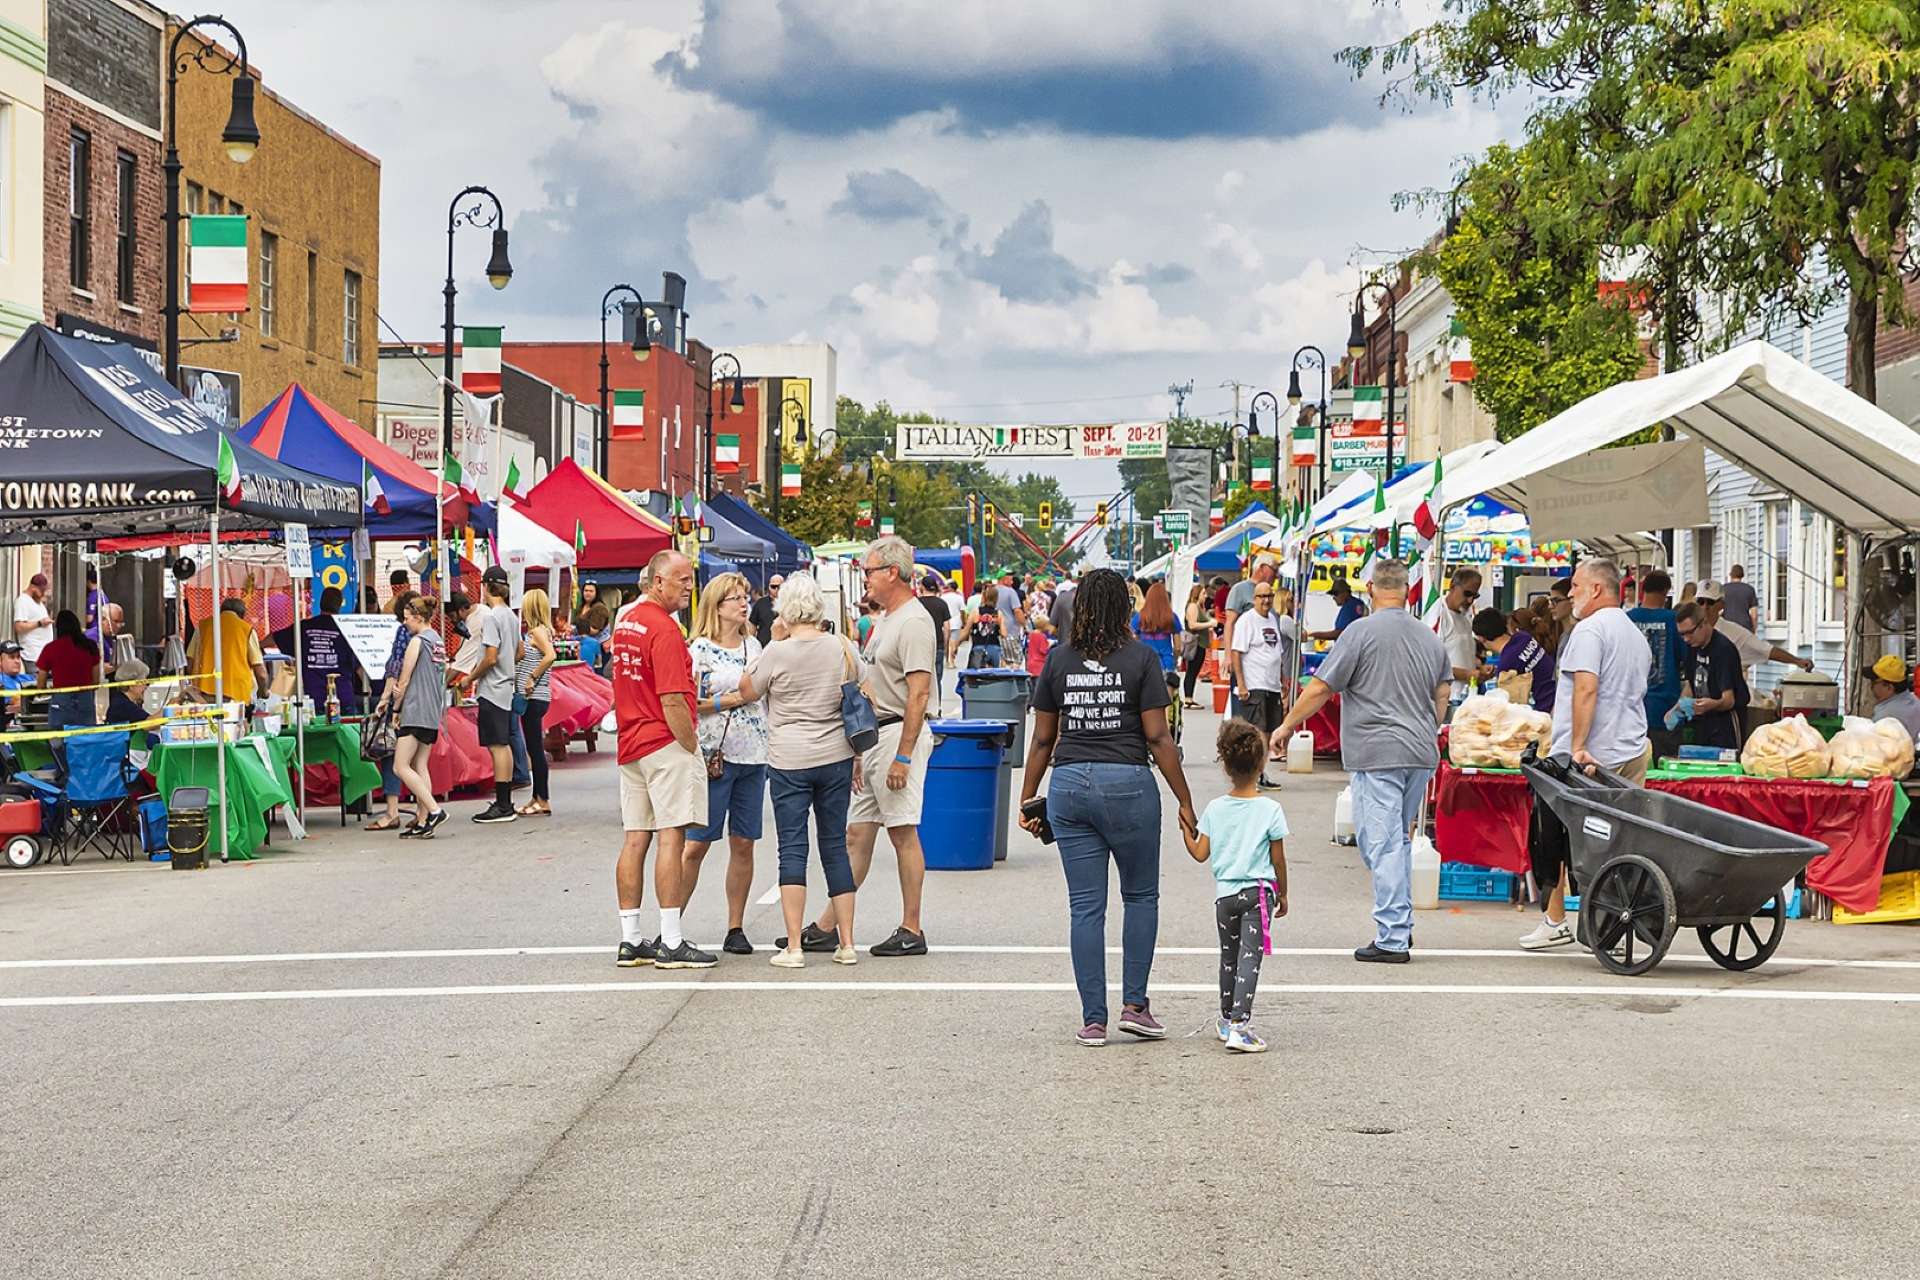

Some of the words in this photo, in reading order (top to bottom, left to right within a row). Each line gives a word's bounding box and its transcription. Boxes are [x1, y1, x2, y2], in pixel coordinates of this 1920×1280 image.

[0, 416, 27, 427] ST
[0, 429, 104, 439] METOWN
[392, 421, 463, 447] Bieges
[904, 427, 995, 450] ITALIAN
[1022, 427, 1077, 450] FEST
[1083, 426, 1116, 442] SEPT.
[1127, 426, 1162, 441] 20-21
[1066, 673, 1102, 687] RUNNING
[1104, 673, 1113, 686] IS
[1115, 673, 1121, 686] A
[1064, 692, 1095, 705] MENTAL
[1097, 691, 1126, 704] SPORT
[1086, 707, 1100, 719] WE
[1102, 707, 1121, 718] ARE
